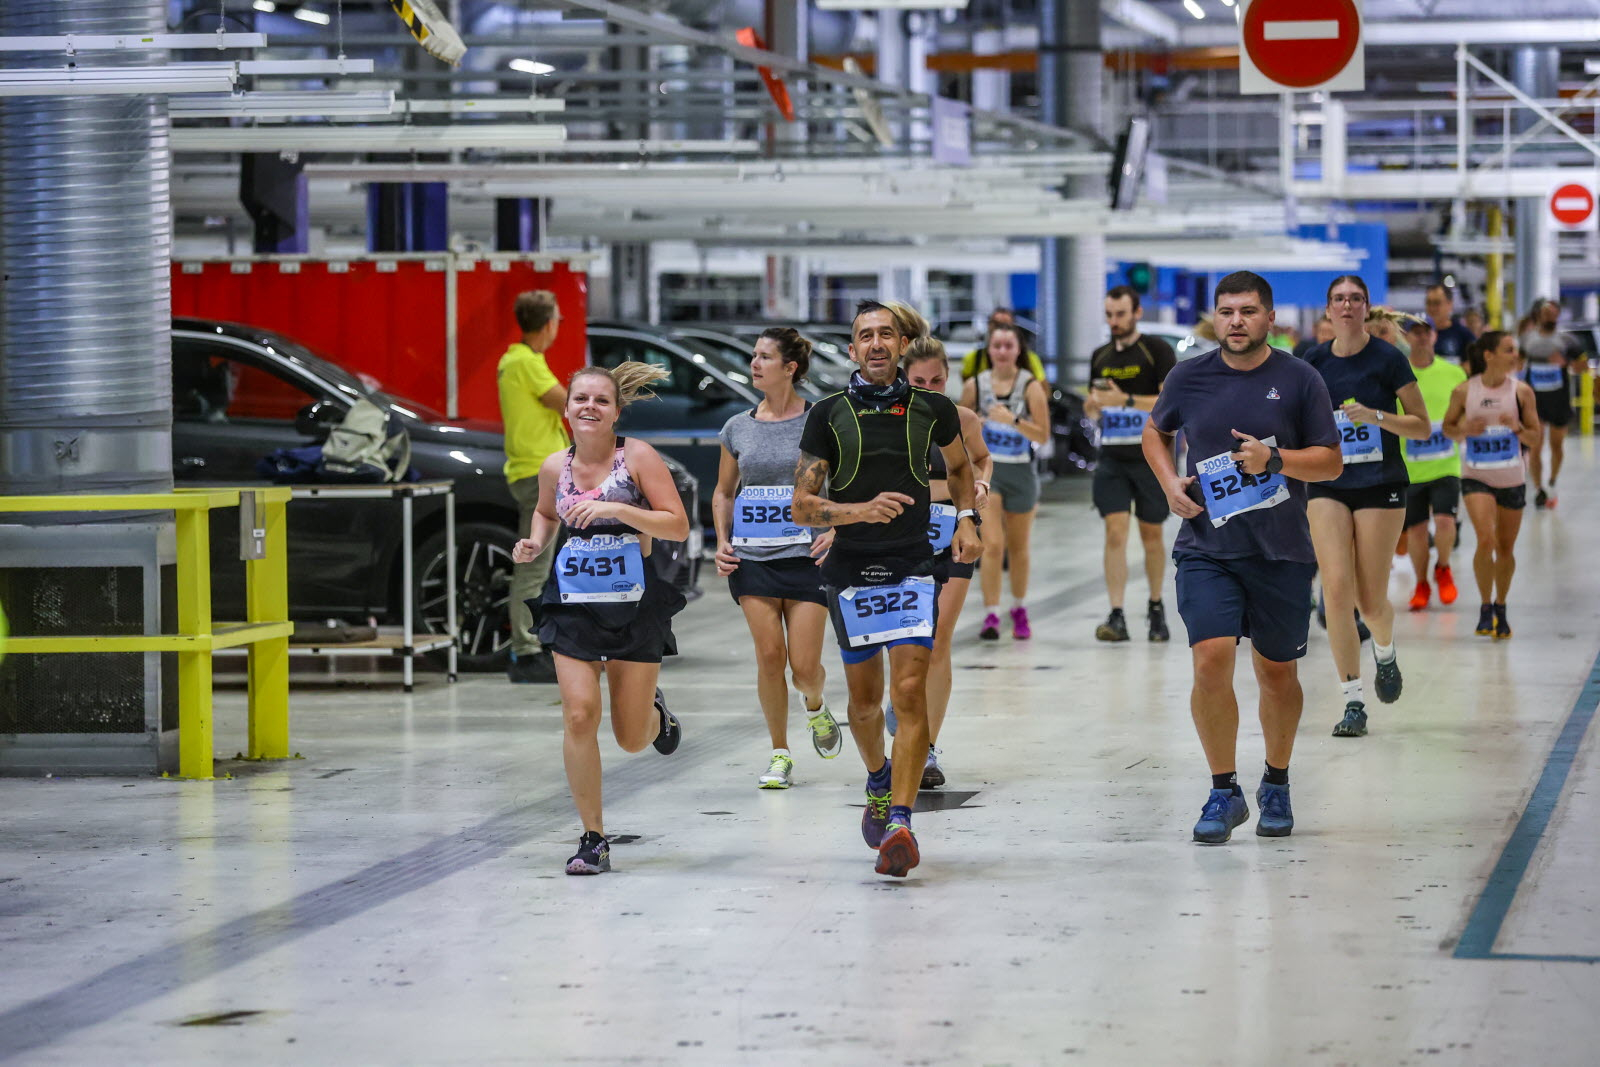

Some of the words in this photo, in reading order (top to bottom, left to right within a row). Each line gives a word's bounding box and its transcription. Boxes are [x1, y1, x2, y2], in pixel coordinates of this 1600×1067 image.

[1203, 455, 1230, 473] 3008
[740, 488, 765, 498] 3008
[767, 487, 793, 498] RUN
[742, 504, 794, 524] 5326
[592, 535, 625, 548] RUN
[563, 555, 627, 577] 5431
[854, 590, 919, 619] 5322
